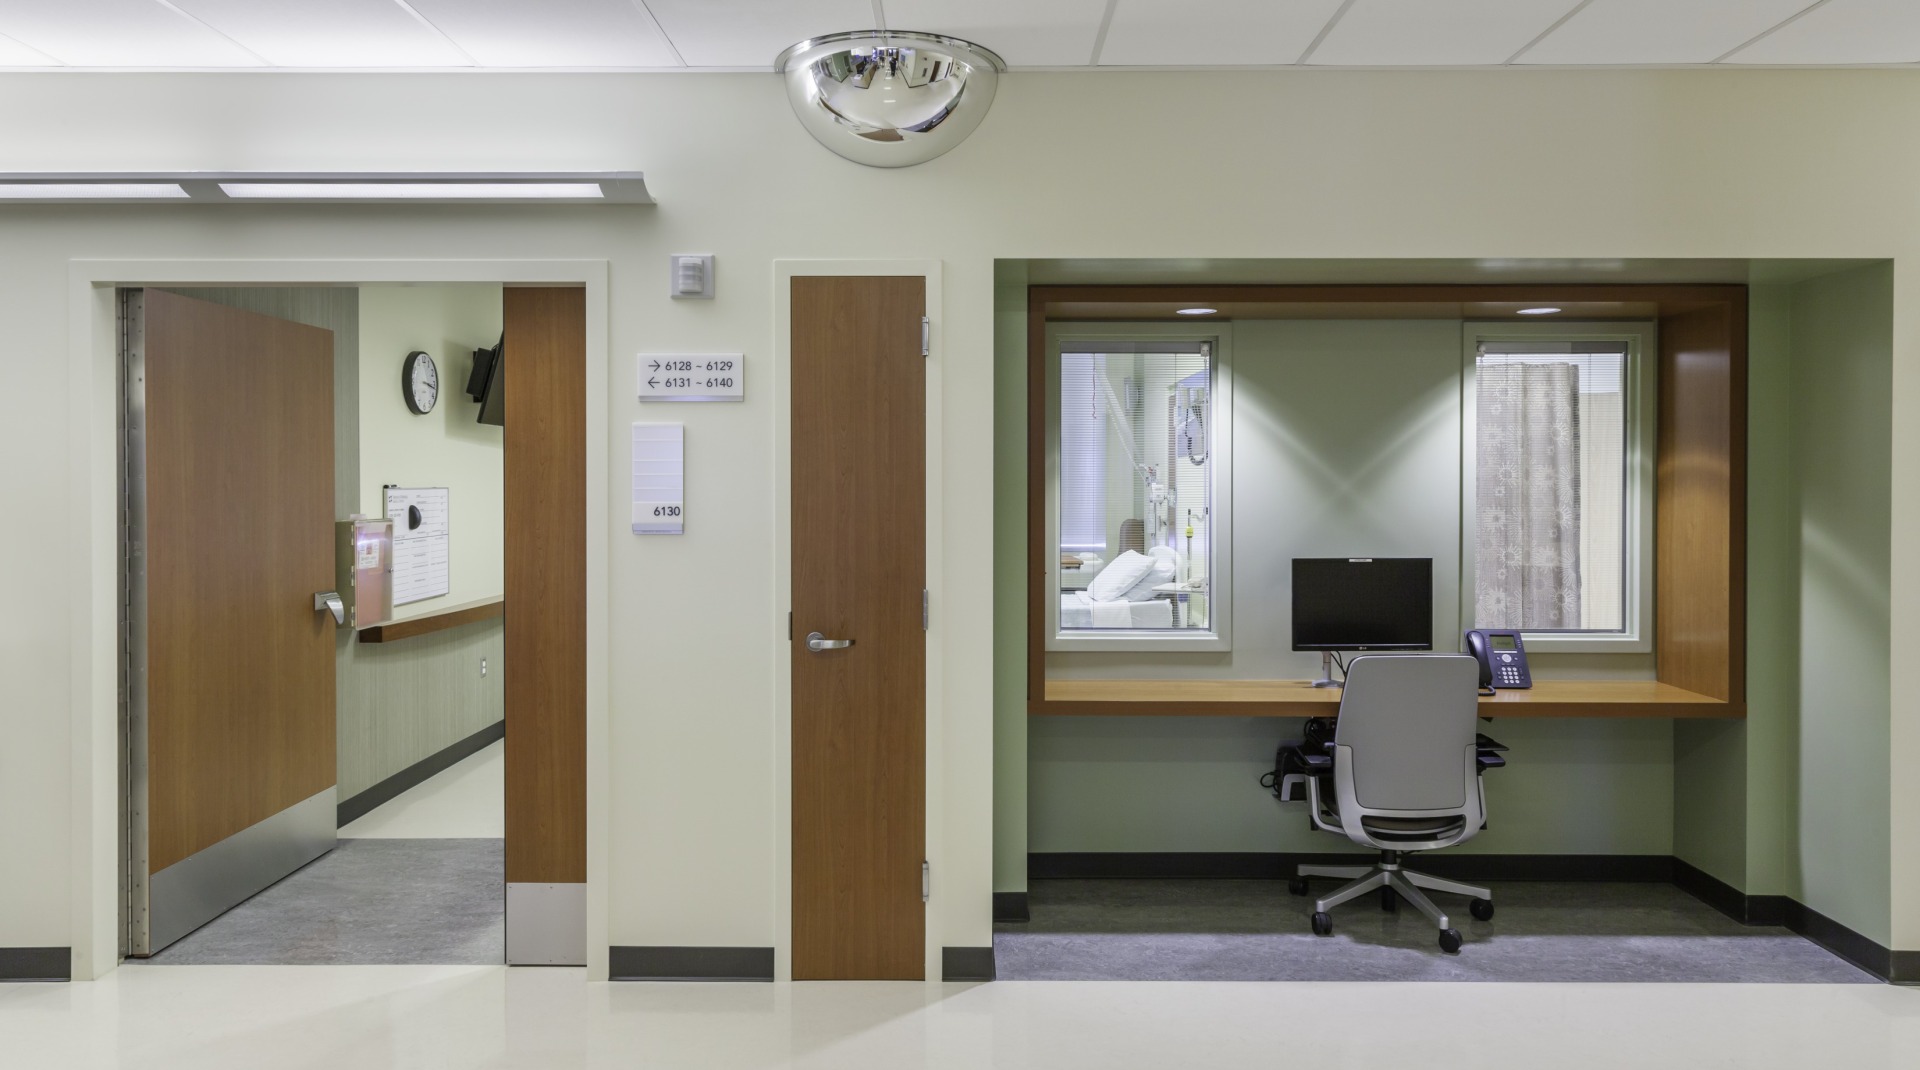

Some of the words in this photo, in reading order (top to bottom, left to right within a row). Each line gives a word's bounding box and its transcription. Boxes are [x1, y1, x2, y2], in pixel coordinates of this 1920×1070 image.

[421, 355, 427, 364] 12
[665, 361, 692, 371] 6128
[706, 361, 733, 371] 6129
[665, 378, 691, 388] 6131
[706, 378, 733, 388] 6140
[653, 506, 681, 517] 6130
